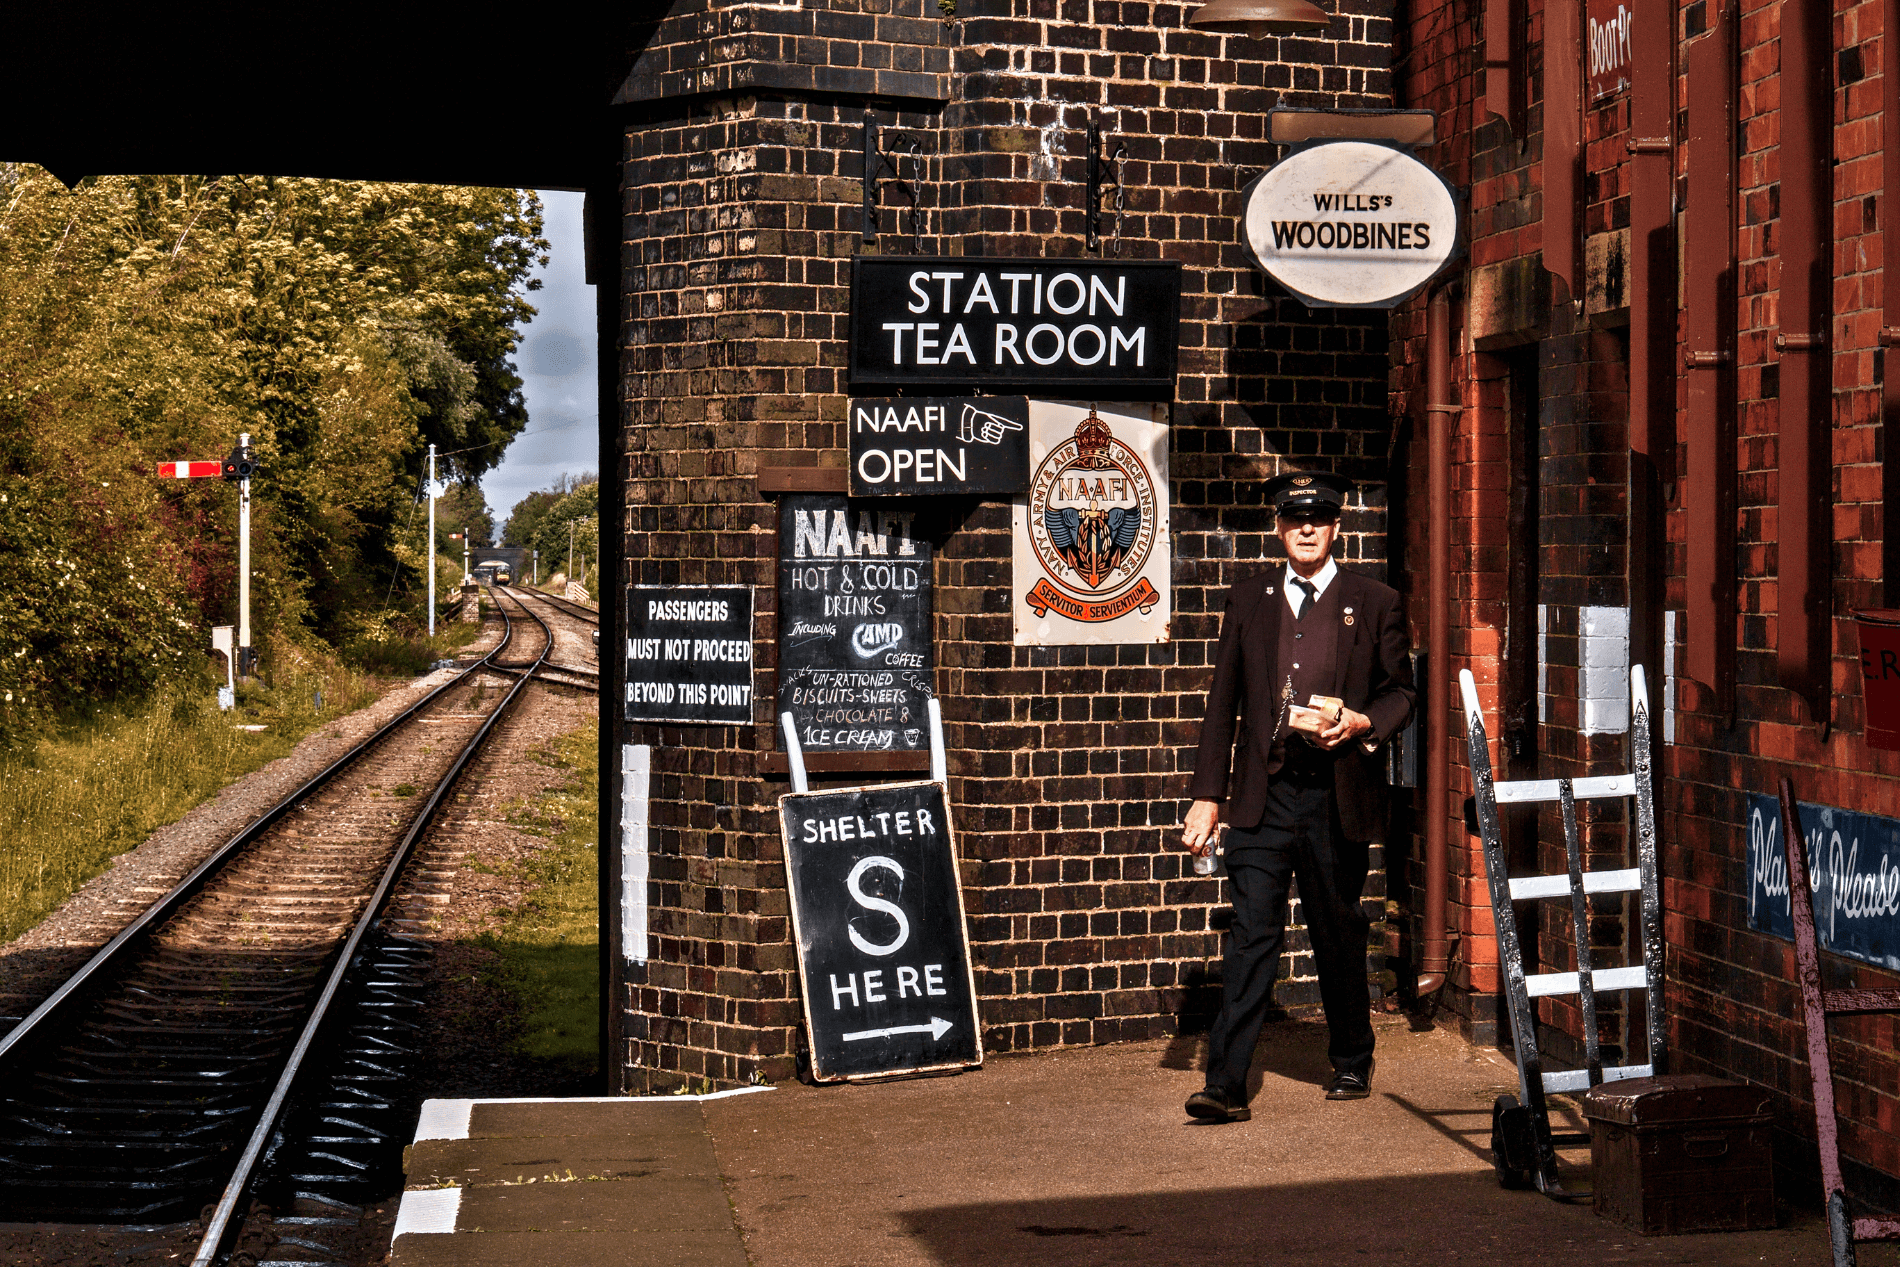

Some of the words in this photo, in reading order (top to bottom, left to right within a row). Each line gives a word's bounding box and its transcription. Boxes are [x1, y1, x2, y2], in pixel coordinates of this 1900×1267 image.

[1590, 17, 1617, 77] BOOT
[1271, 220, 1431, 250] WOODBINES
[908, 271, 1126, 316] STATION
[882, 322, 977, 365] TEA
[995, 323, 1146, 367] ROOM
[856, 406, 946, 433] NAAFI
[858, 448, 966, 484] OPEN
[1053, 446, 1077, 471] AIR
[1043, 469, 1055, 481] &
[1033, 477, 1050, 528] ARMY
[794, 509, 917, 557] NAAFI
[1121, 487, 1152, 577] INSTITUTES
[1036, 536, 1066, 577] NAVY
[792, 566, 834, 591] HOT
[840, 564, 855, 594] &
[863, 564, 919, 591] COLD
[648, 600, 729, 621] PASSENGERS
[824, 595, 886, 617] DRINKS
[1039, 584, 1084, 617] SERVITOR
[1089, 584, 1147, 618] SERVIENTIUM
[788, 621, 837, 636] INCLUDING
[852, 622, 903, 659] CAMP
[627, 638, 661, 660] MUST
[664, 638, 691, 661] NOT
[693, 639, 751, 662] PROCEED
[885, 652, 925, 668] COFFEE
[627, 682, 675, 703] BEYOND
[678, 683, 707, 705] THIS
[710, 684, 751, 706] POINT
[812, 672, 894, 688] UN-RATIONED
[815, 707, 893, 724] CHOCOLATE
[900, 706, 910, 724] &
[834, 729, 893, 751] CREAM
[802, 808, 936, 844] SHELTER
[1752, 807, 1823, 917] Play's
[1829, 830, 1900, 942] Please
[847, 855, 910, 956] S
[829, 964, 947, 1010] HERE
